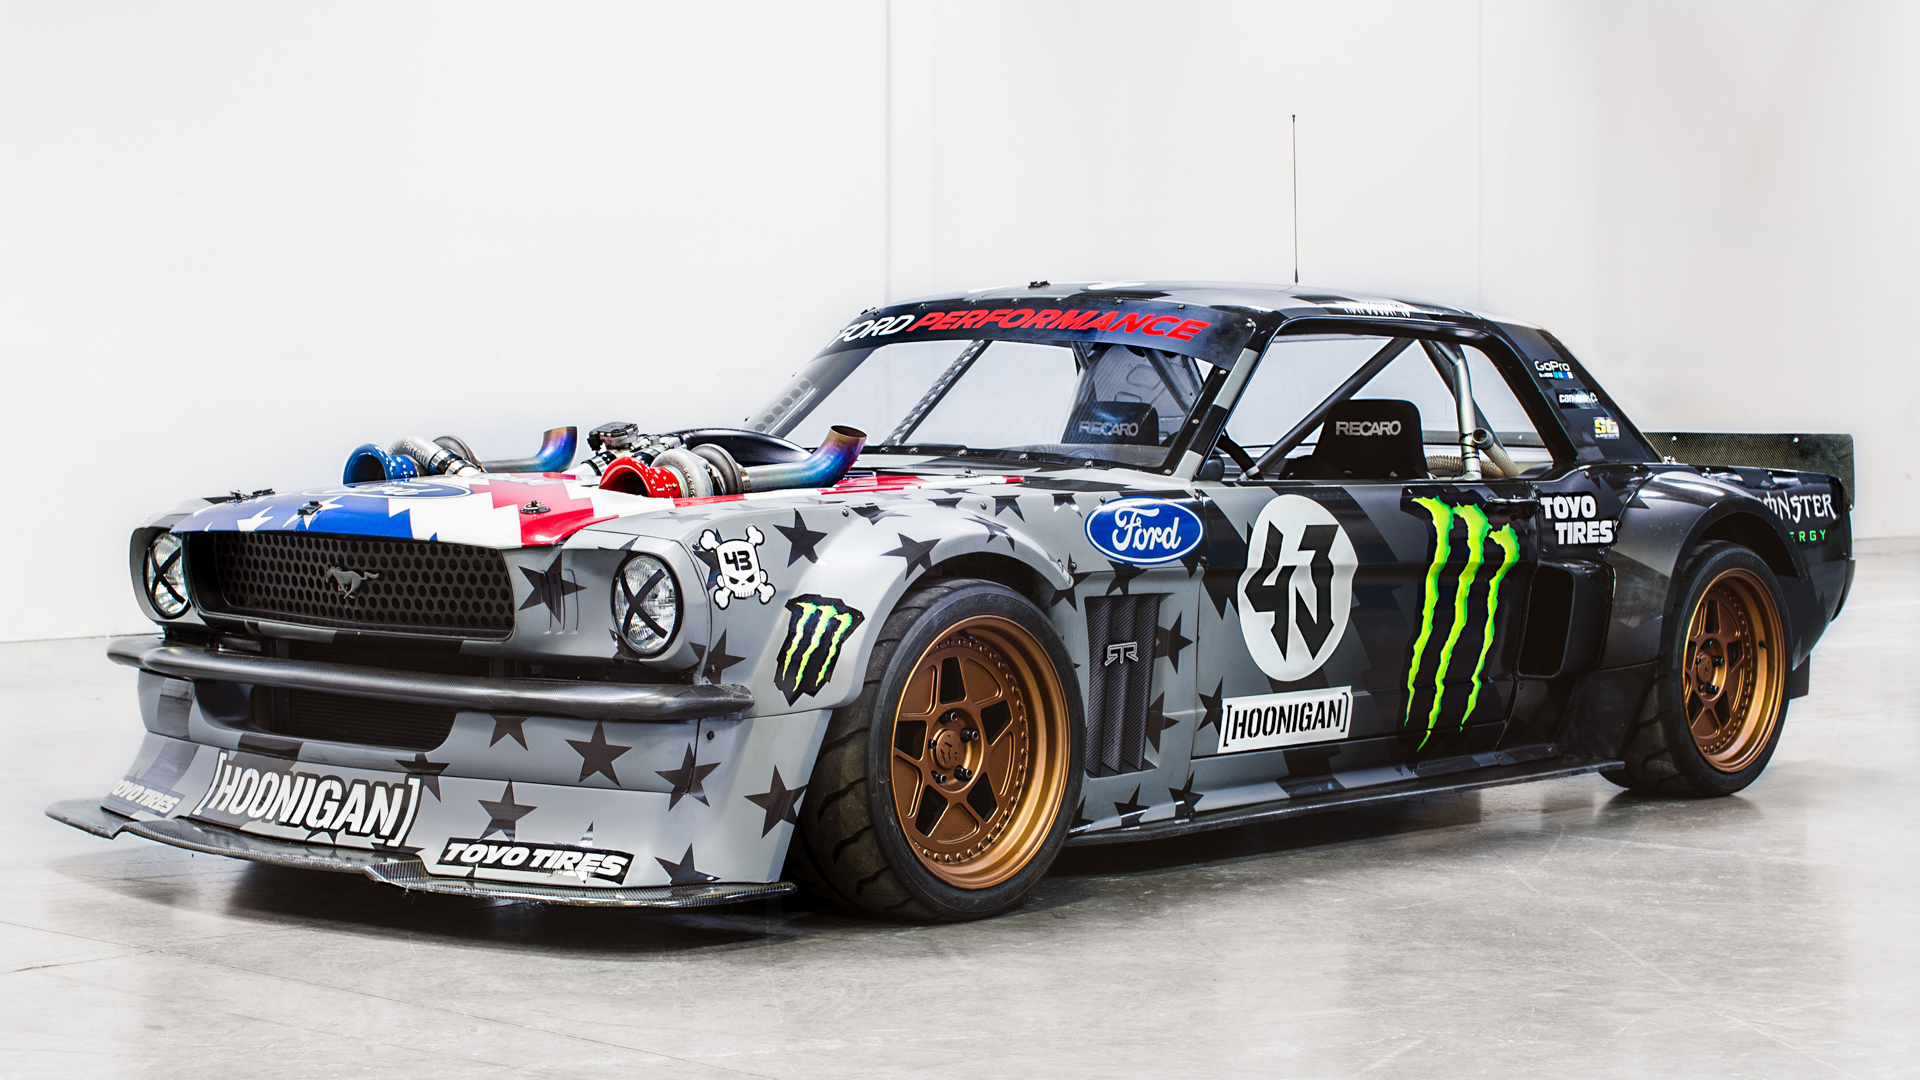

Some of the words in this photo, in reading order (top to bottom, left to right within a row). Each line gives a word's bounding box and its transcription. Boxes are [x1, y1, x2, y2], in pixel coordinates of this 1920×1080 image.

[826, 314, 915, 348] FORD
[906, 308, 1211, 342] PERFORMANCE
[1534, 360, 1571, 372] GoPro
[1079, 420, 1139, 437] RECARO
[1335, 420, 1402, 437] RECARO
[1540, 495, 1597, 519] TOYO
[1757, 489, 1838, 524] ONSTER
[1112, 507, 1182, 551] Ford
[1555, 520, 1613, 545] TIRES
[723, 550, 753, 571] 43
[1223, 692, 1350, 747] [HOONIGAN]
[135, 788, 181, 814] TIRES
[192, 751, 421, 847] [HOONIGAN]
[443, 843, 530, 867] TOYO
[529, 848, 629, 877] TIRES
